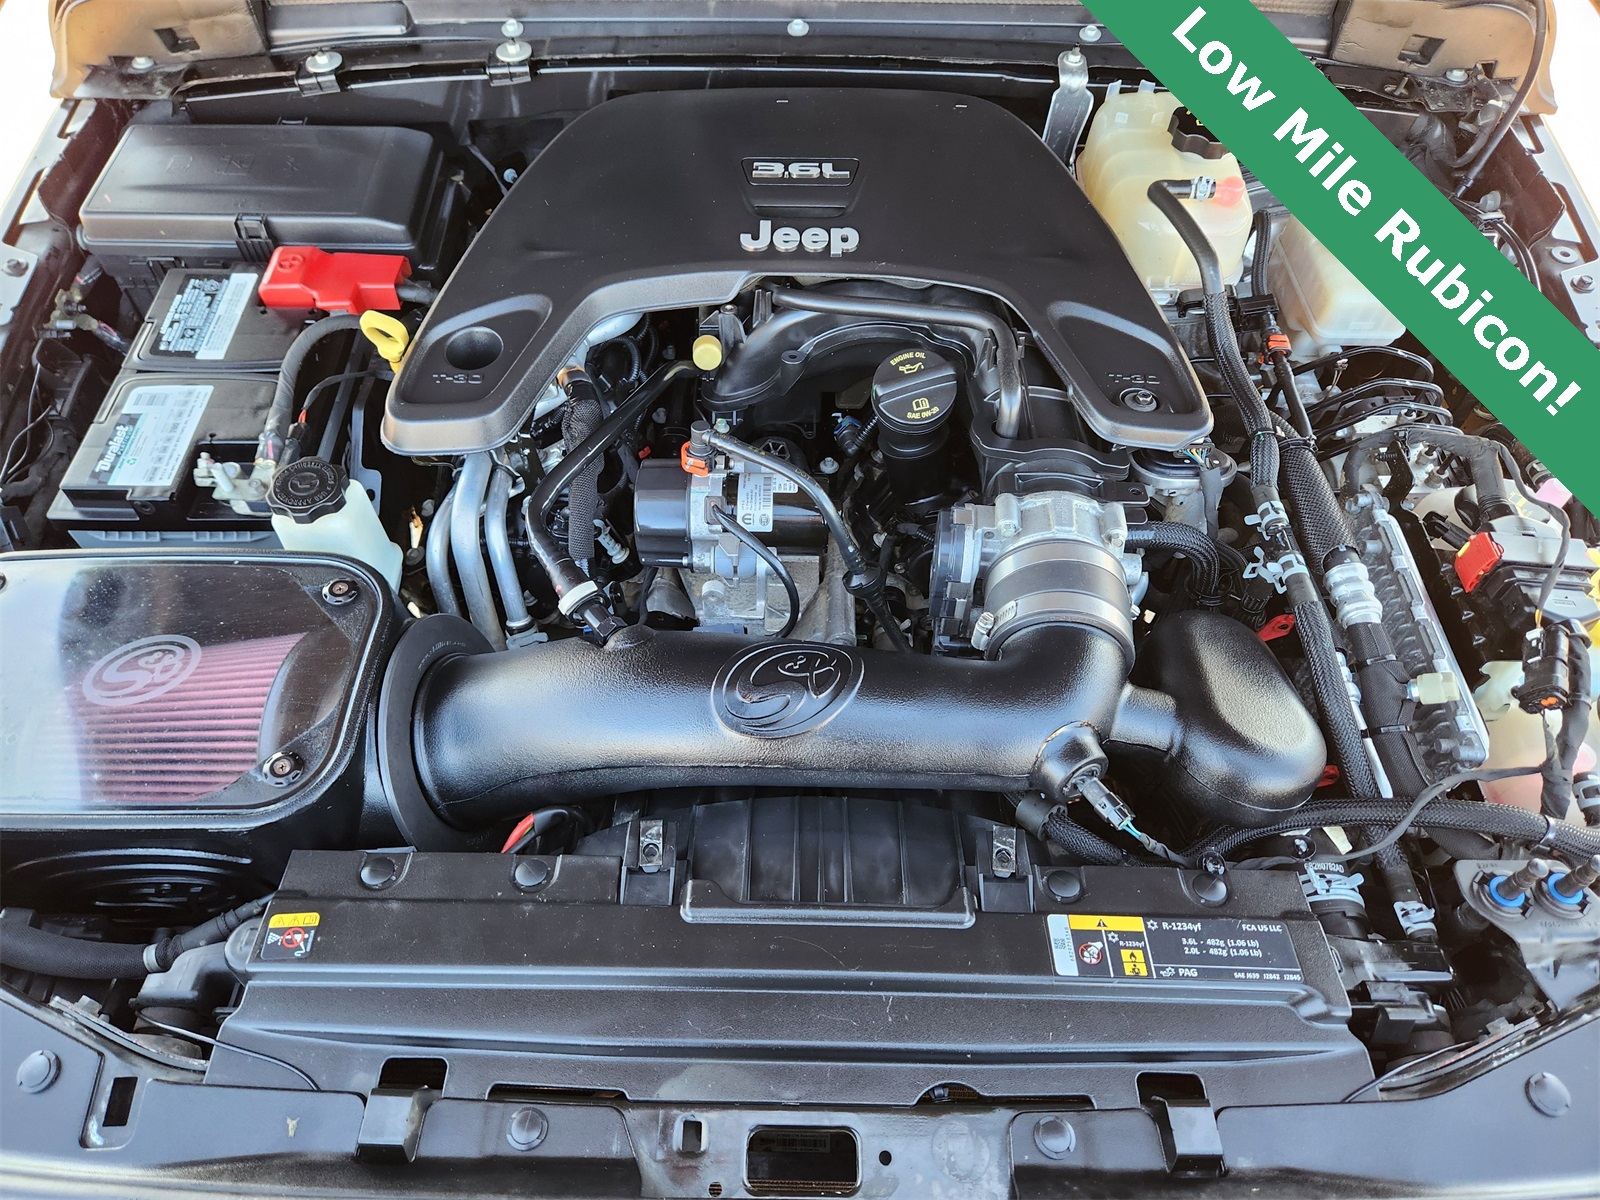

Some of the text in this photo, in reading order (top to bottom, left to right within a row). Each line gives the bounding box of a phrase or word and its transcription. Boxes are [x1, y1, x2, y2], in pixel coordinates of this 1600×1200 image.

[752, 162, 850, 178] 3.6L
[740, 219, 860, 257] Jeep
[890, 352, 914, 366] ENGINE
[95, 425, 129, 472] Duralast
[1162, 922, 1202, 932] R-1234yf
[1258, 924, 1268, 932] US
[1207, 939, 1225, 947] 482g
[1227, 939, 1246, 947] (1.06
[1209, 948, 1228, 957] 482g
[1230, 948, 1249, 957] (1.06
[1179, 968, 1198, 977] PAG
